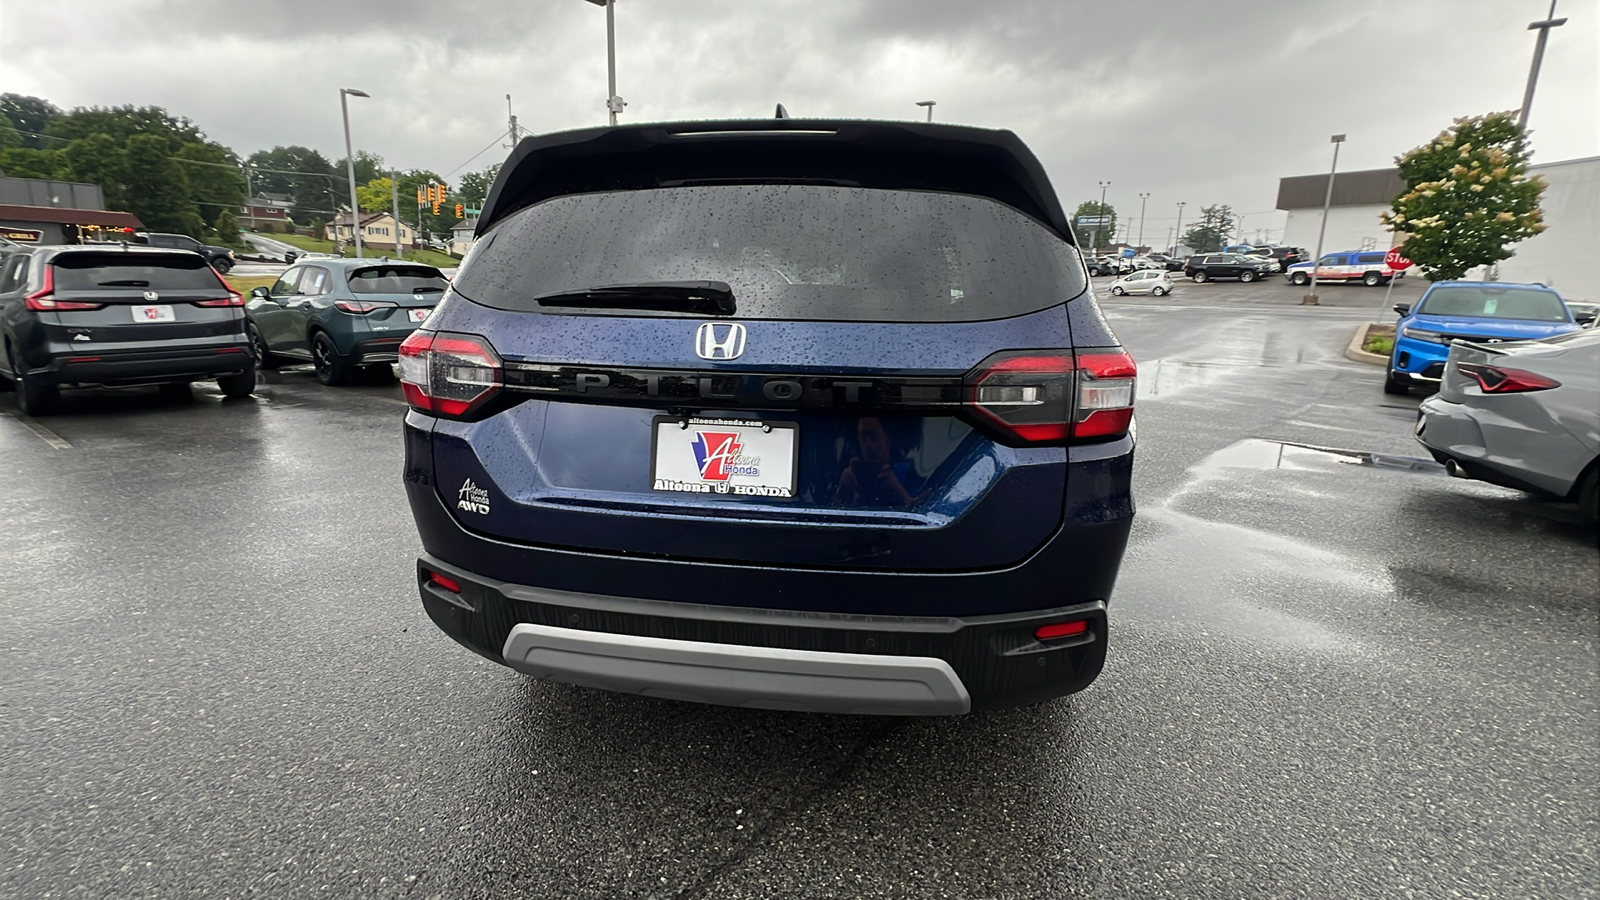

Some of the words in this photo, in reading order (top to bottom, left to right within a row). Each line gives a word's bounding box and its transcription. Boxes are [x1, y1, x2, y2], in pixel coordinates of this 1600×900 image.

[576, 373, 873, 403] PILOT
[688, 418, 763, 426] altoonahonda.com
[701, 436, 760, 475] Altoona
[724, 464, 759, 475] Honda
[653, 479, 711, 493] Altoona
[734, 485, 792, 498] HONDA
[470, 494, 490, 505] Honda
[457, 500, 490, 515] AWD
